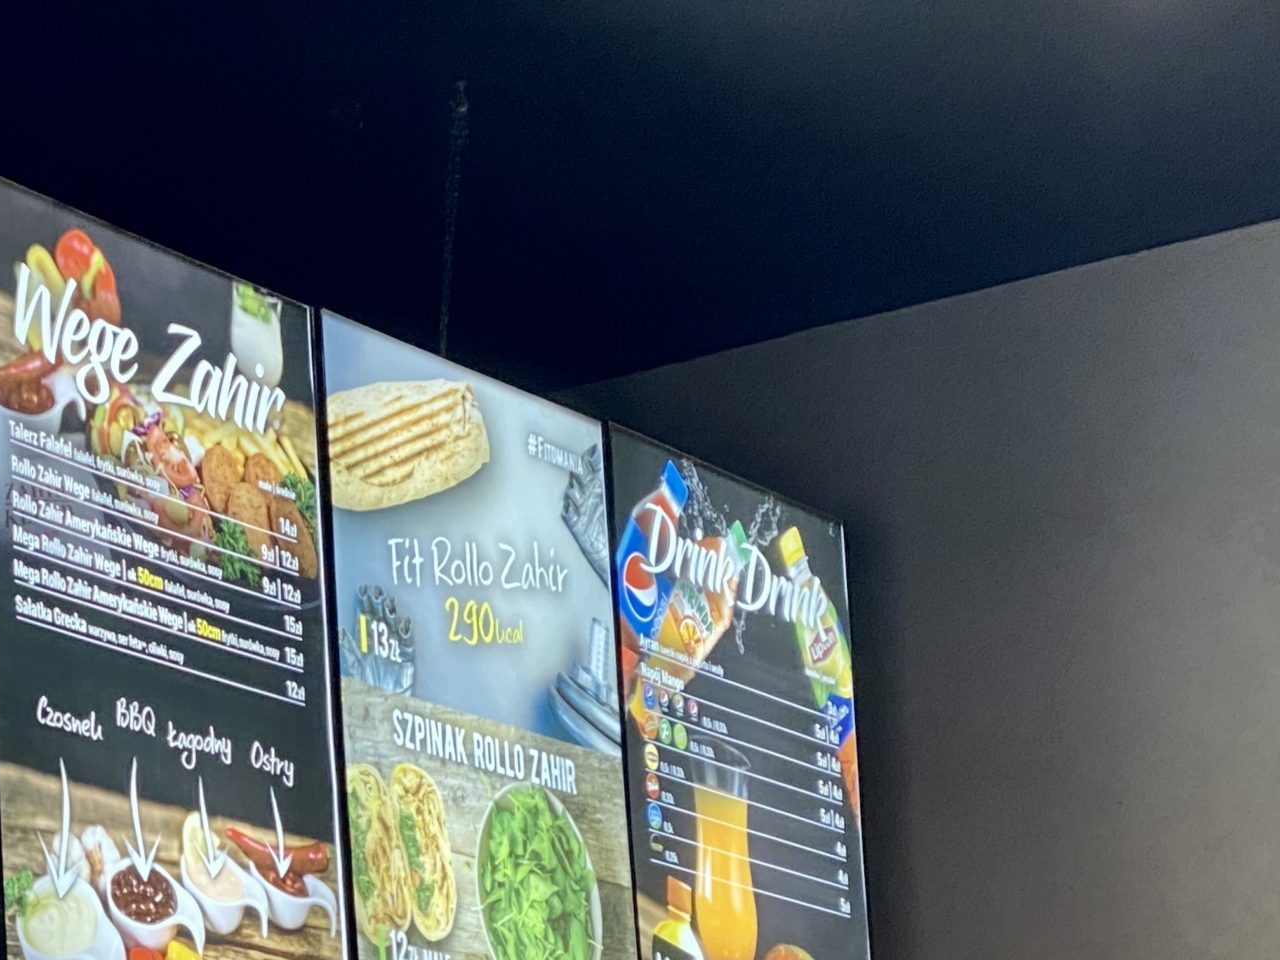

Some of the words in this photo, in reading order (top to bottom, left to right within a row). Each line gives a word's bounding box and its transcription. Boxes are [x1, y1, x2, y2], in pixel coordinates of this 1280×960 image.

[14, 262, 139, 405] Wege
[151, 323, 286, 435] Zahir
[9, 420, 38, 446] Talerz
[40, 431, 72, 458] Falafel
[11, 454, 36, 479] Rollo
[37, 464, 62, 488] Zahir
[63, 474, 90, 500] Wege
[12, 491, 37, 515] Rollo
[38, 500, 64, 524] Zahir
[132, 533, 159, 558] Wege
[13, 524, 40, 550] Mega
[41, 534, 66, 558] Rollo
[67, 543, 92, 567] Zahir
[94, 552, 121, 578] Wege
[137, 566, 163, 590] 50cm
[387, 536, 424, 588] Fit
[431, 536, 494, 587] Rollo
[498, 540, 568, 593] Zahir
[640, 503, 739, 608] Drink
[737, 542, 828, 642] Drink
[13, 559, 40, 585] Mega
[41, 568, 66, 592] Rollo
[67, 577, 92, 600] Zahir
[157, 605, 183, 631] Wege
[196, 617, 221, 641] 50cm
[53, 607, 87, 634] Grecka
[36, 695, 104, 741] Czosnek
[116, 697, 157, 737] BBQ
[167, 721, 232, 770] Łagodny
[250, 740, 295, 788] Ostry
[392, 708, 468, 765] SZPINAK
[473, 732, 525, 780] ROLLO
[529, 748, 578, 795] ZAHIR
